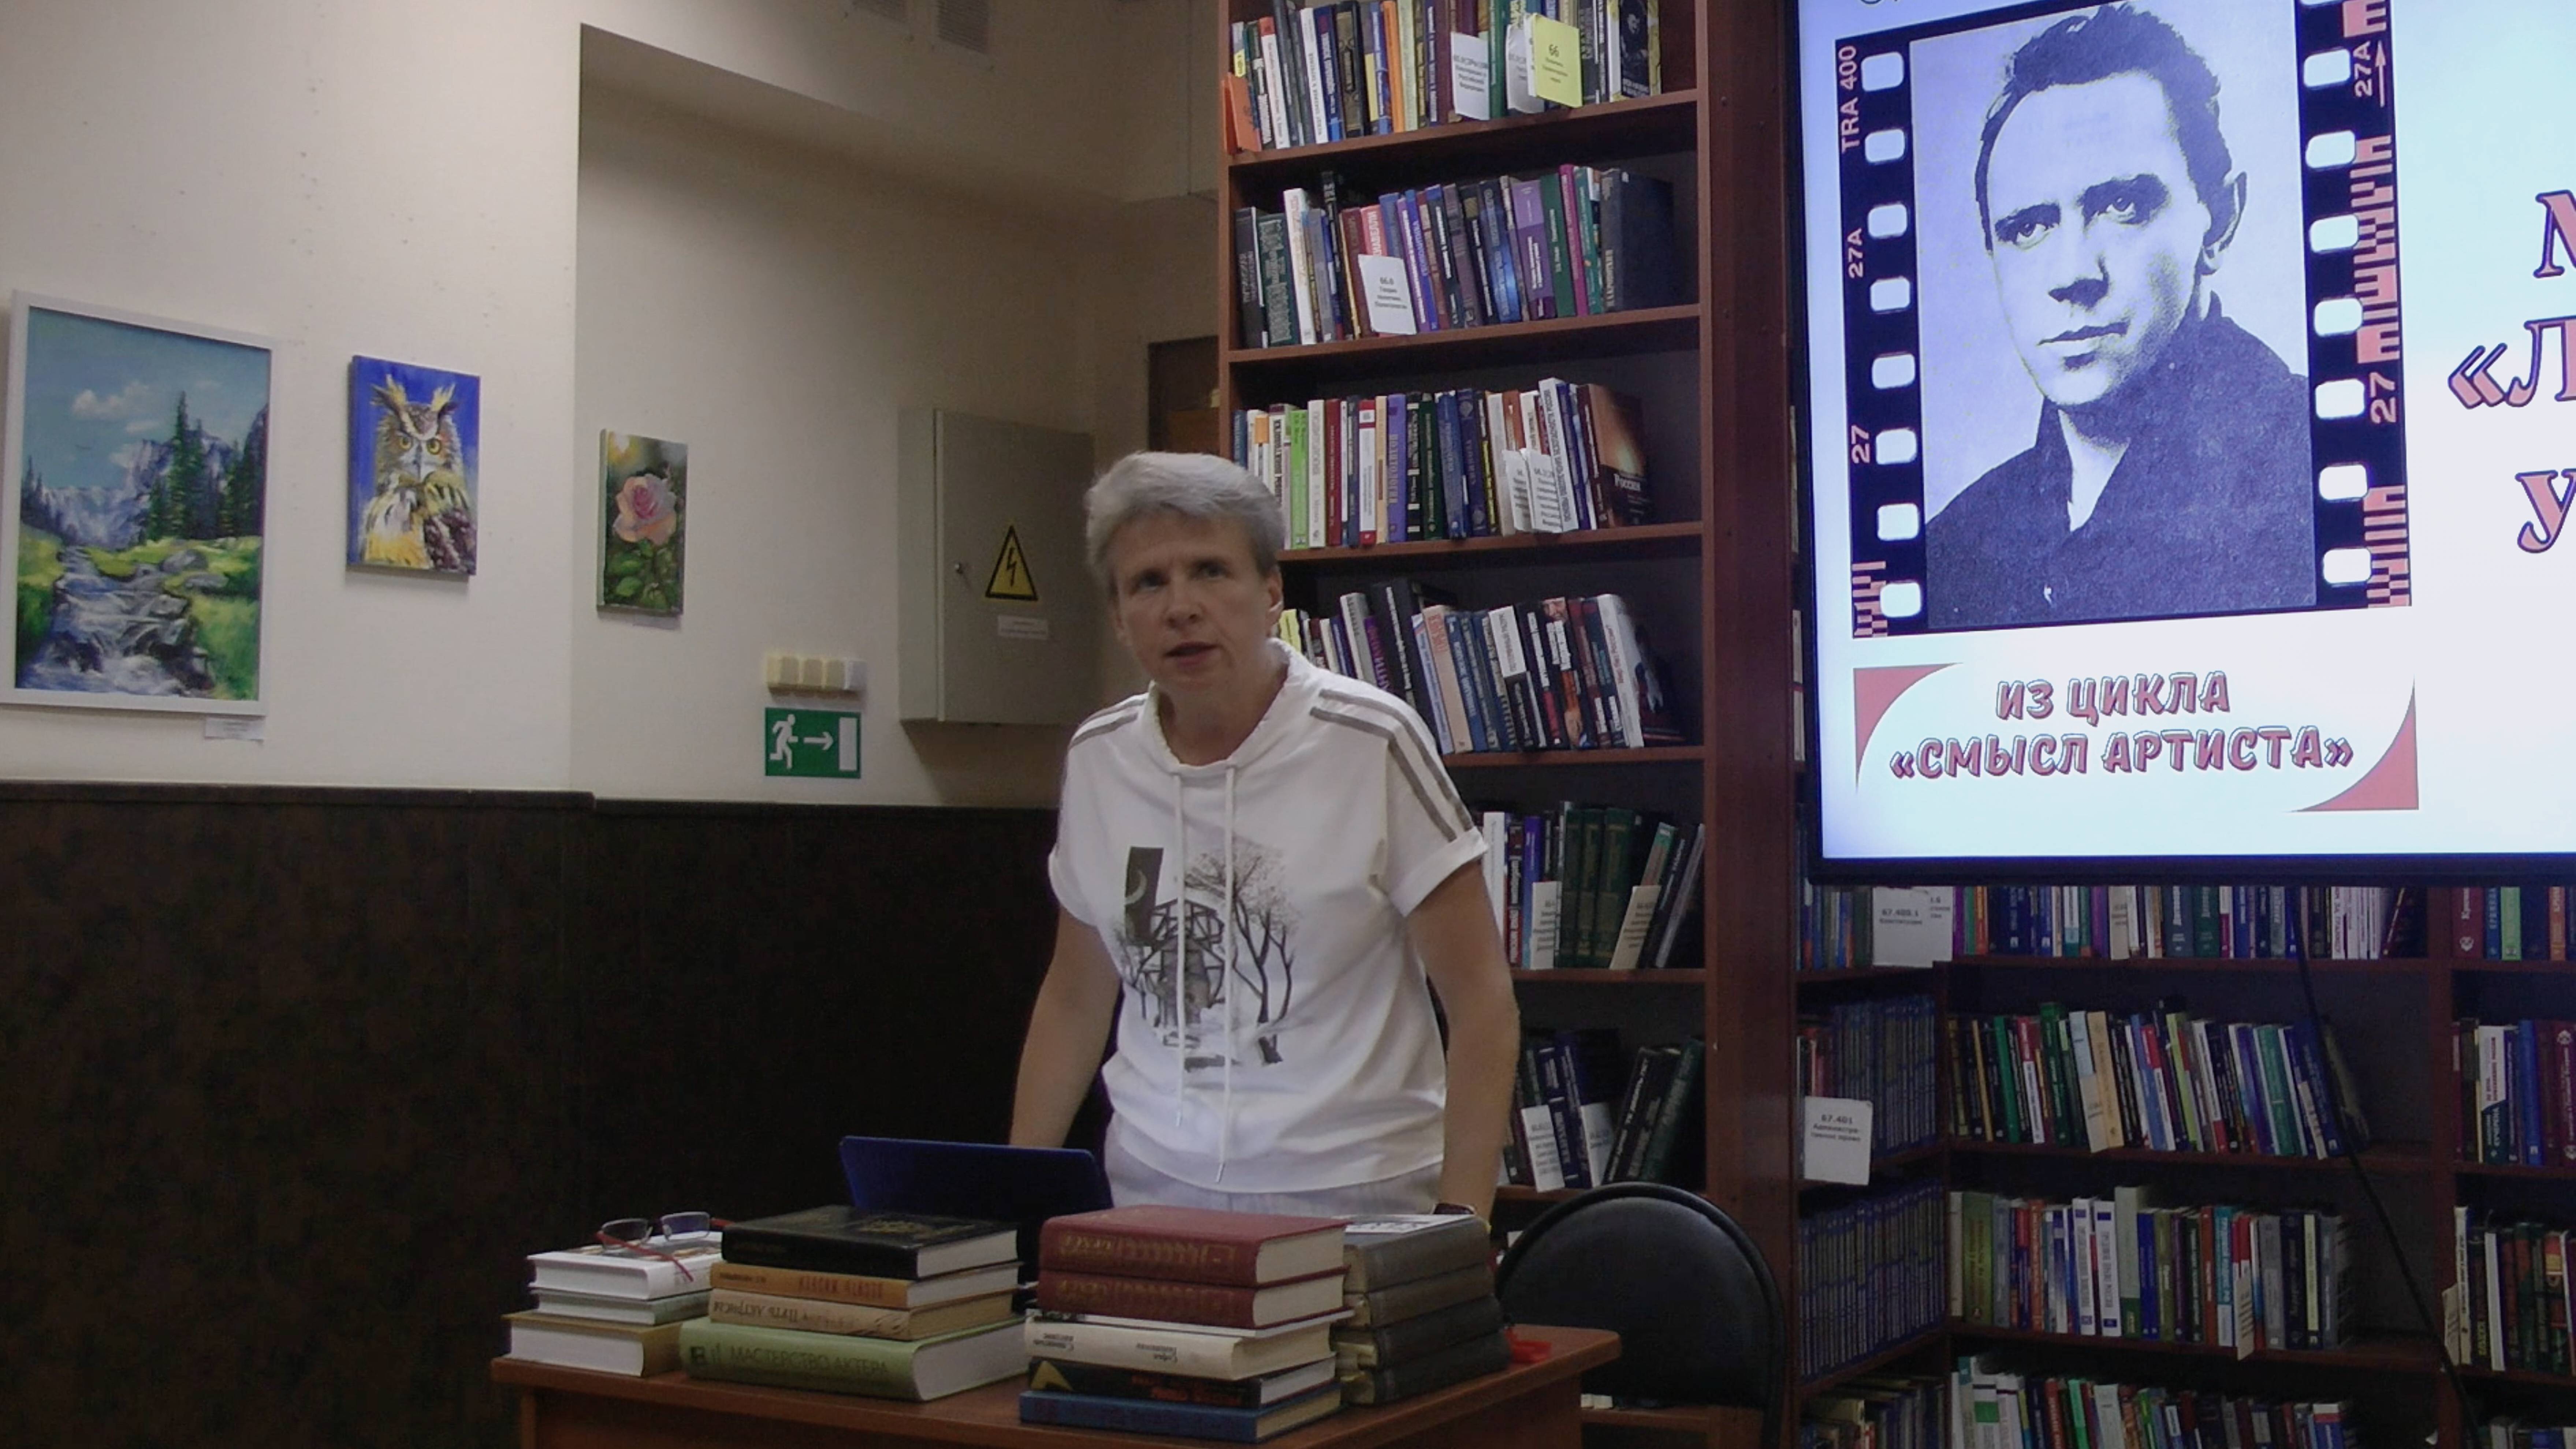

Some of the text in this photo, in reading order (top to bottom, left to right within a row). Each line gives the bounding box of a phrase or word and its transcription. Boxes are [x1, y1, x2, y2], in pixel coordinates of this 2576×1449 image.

[2353, 41, 2373, 97] 27A
[1838, 45, 1860, 153] TRA 400
[1849, 228, 1864, 279] 27A
[2369, 371, 2397, 425] 27
[1851, 425, 1870, 464] 27
[1996, 670, 2230, 727] ИЗ ЦИКЛА
[1890, 725, 2354, 779] «СМЫСЛ АРТИСТА»
[731, 1346, 829, 1371] МАСТЕРСТВО
